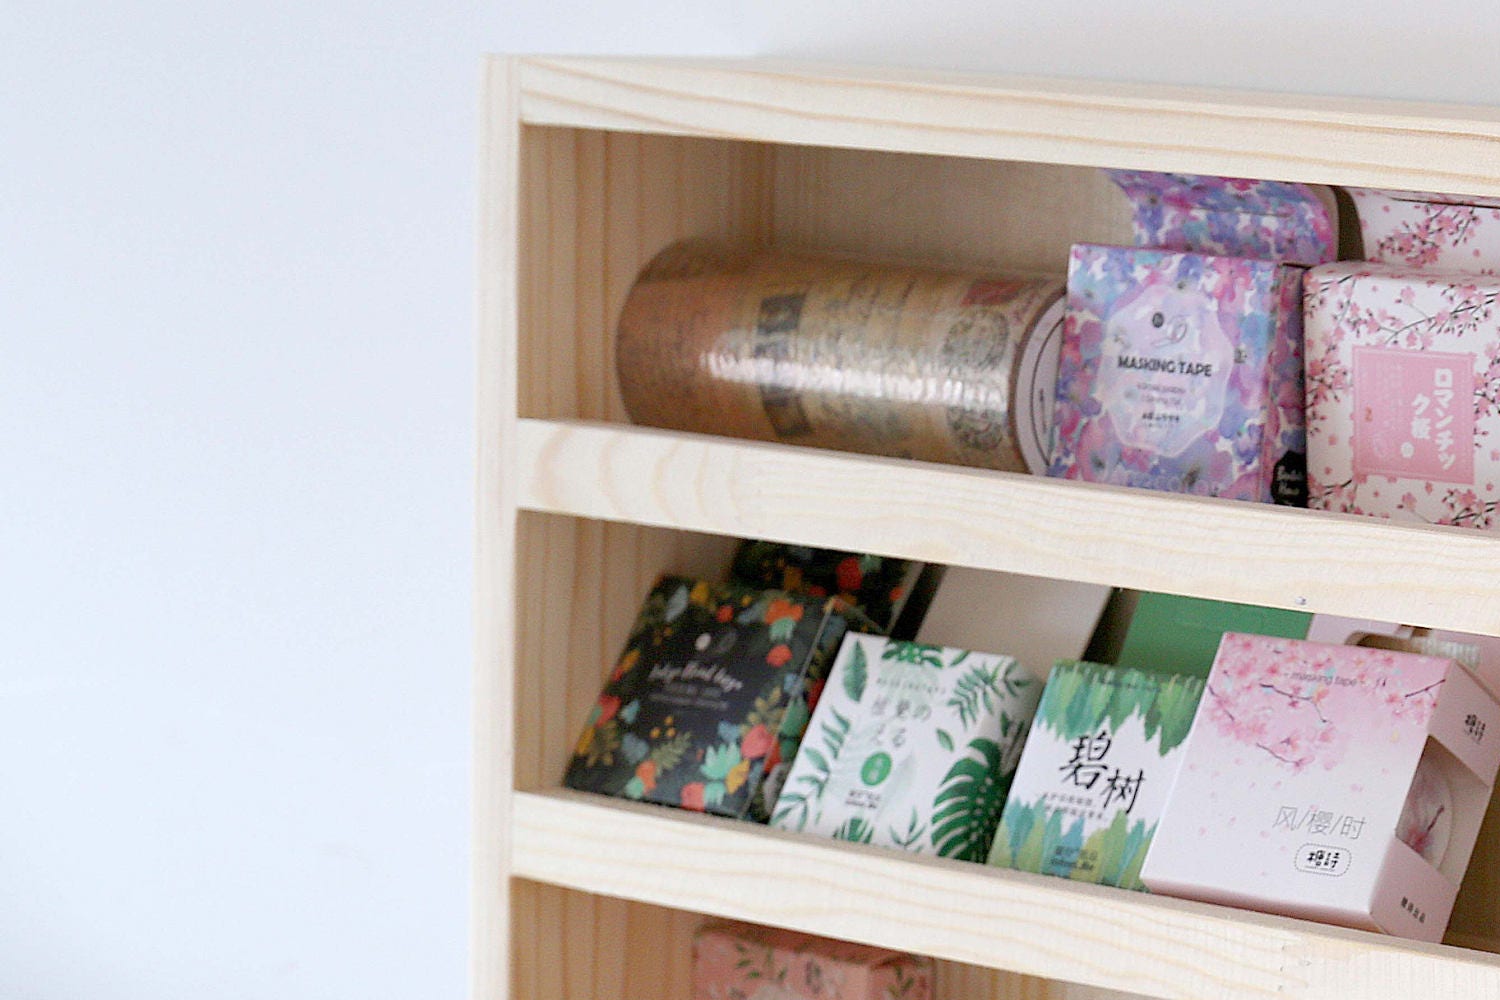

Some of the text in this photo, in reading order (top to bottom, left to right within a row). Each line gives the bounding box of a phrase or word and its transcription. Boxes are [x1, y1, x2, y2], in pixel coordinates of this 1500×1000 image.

[1117, 355, 1213, 377] MASKING TAPE
[1058, 729, 1146, 815] 碧树
